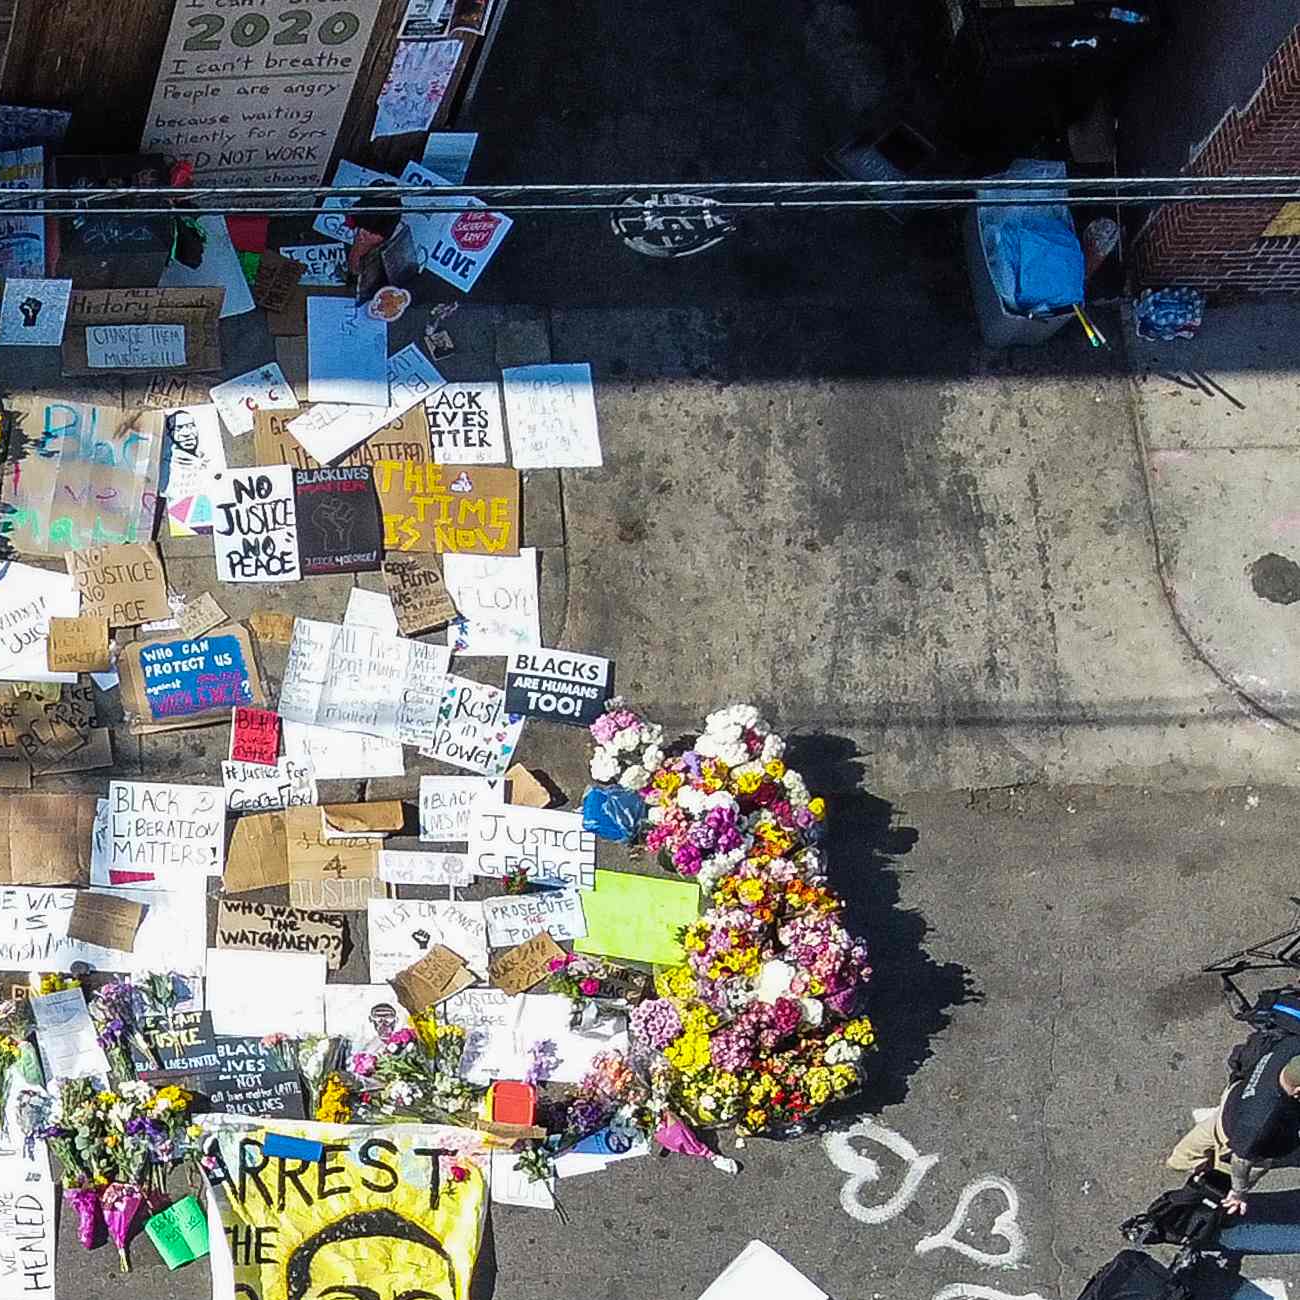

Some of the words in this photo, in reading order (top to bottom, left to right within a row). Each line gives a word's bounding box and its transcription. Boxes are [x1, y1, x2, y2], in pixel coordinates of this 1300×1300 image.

[182, 11, 361, 51] 2020
[196, 55, 254, 73] can't
[265, 54, 353, 70] breathe
[164, 85, 221, 100] People
[236, 85, 270, 95] are
[154, 115, 231, 128] because
[241, 109, 314, 123] waiting
[248, 127, 278, 137] for
[217, 149, 260, 165] NOT
[264, 145, 319, 161] WORK
[431, 240, 476, 278] LOVE
[71, 295, 150, 315] History
[233, 475, 272, 499] NO
[375, 459, 447, 494] THE
[216, 500, 295, 536] JUSTICE
[409, 495, 509, 523] TIME
[242, 536, 276, 556] NO
[383, 515, 420, 551] IS
[435, 521, 511, 554] NOW
[79, 561, 155, 586] JUSTICE
[228, 548, 297, 578] PEACE
[143, 647, 174, 663] WHO
[180, 641, 209, 657] CAN
[144, 657, 206, 676] PROTECT
[213, 652, 233, 668] US
[515, 654, 600, 681] BLACKS
[513, 676, 540, 691] ARE
[542, 679, 599, 699] HUMANS
[527, 691, 583, 717] TOO!
[112, 786, 179, 815] BLACK
[481, 814, 595, 852] JUSTICE
[25, 889, 74, 910] WAS
[491, 899, 575, 922] PROSECUTE
[224, 901, 265, 917] WHO
[271, 903, 345, 928] WATCHES
[265, 916, 301, 931] THE
[523, 914, 545, 925] THE
[217, 1044, 269, 1057] BLACK
[237, 1075, 262, 1088] NOT
[14, 1195, 52, 1292] HEALED
